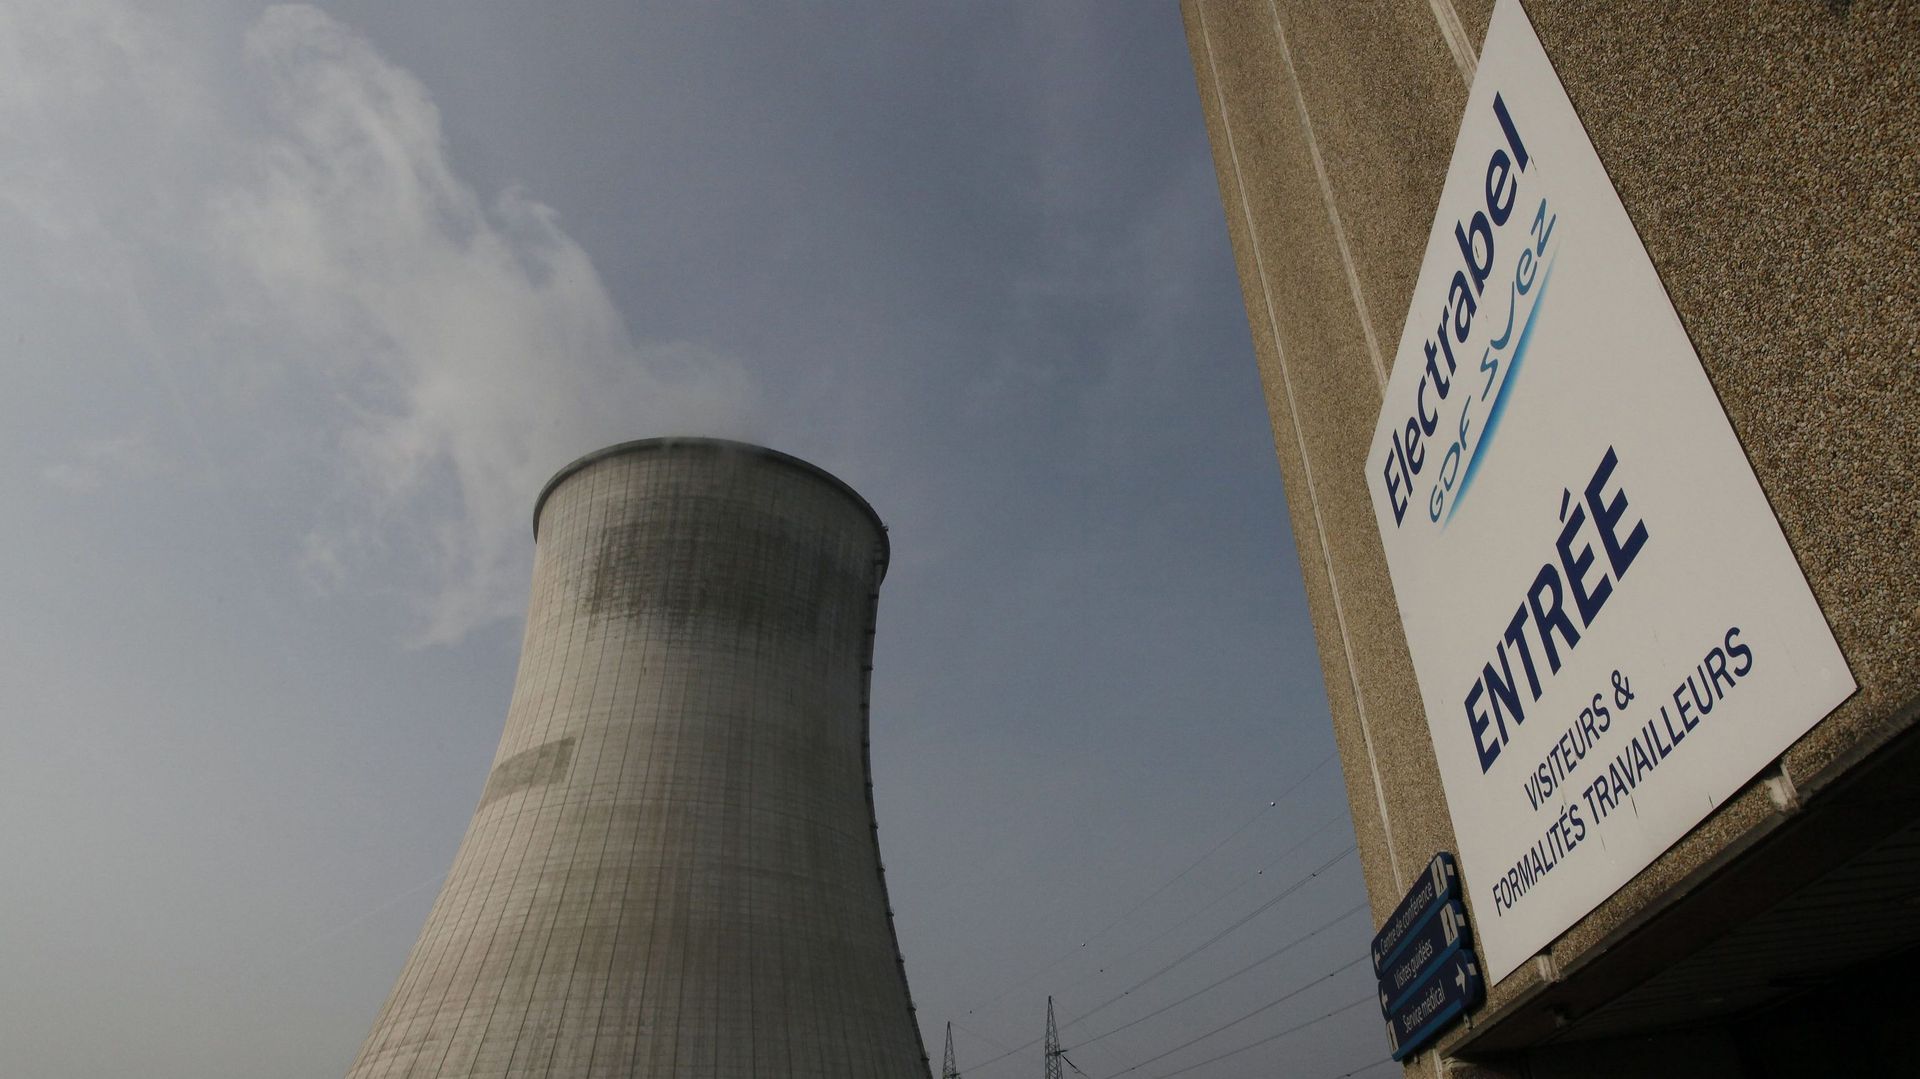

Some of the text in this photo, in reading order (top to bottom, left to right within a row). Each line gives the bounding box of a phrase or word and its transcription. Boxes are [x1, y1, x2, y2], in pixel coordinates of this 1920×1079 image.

[1384, 91, 1529, 528] Electrabel
[1430, 396, 1472, 523] GDF
[1464, 445, 1649, 776] ENTRÉE
[1493, 627, 1753, 917] FORMALITÉS TRAVAILLEURS
[1524, 670, 1635, 812] VISITEURS &
[1380, 882, 1433, 956] Centre de conférence
[1394, 939, 1433, 990] Visites guidées
[1402, 979, 1446, 1034] Service médical
